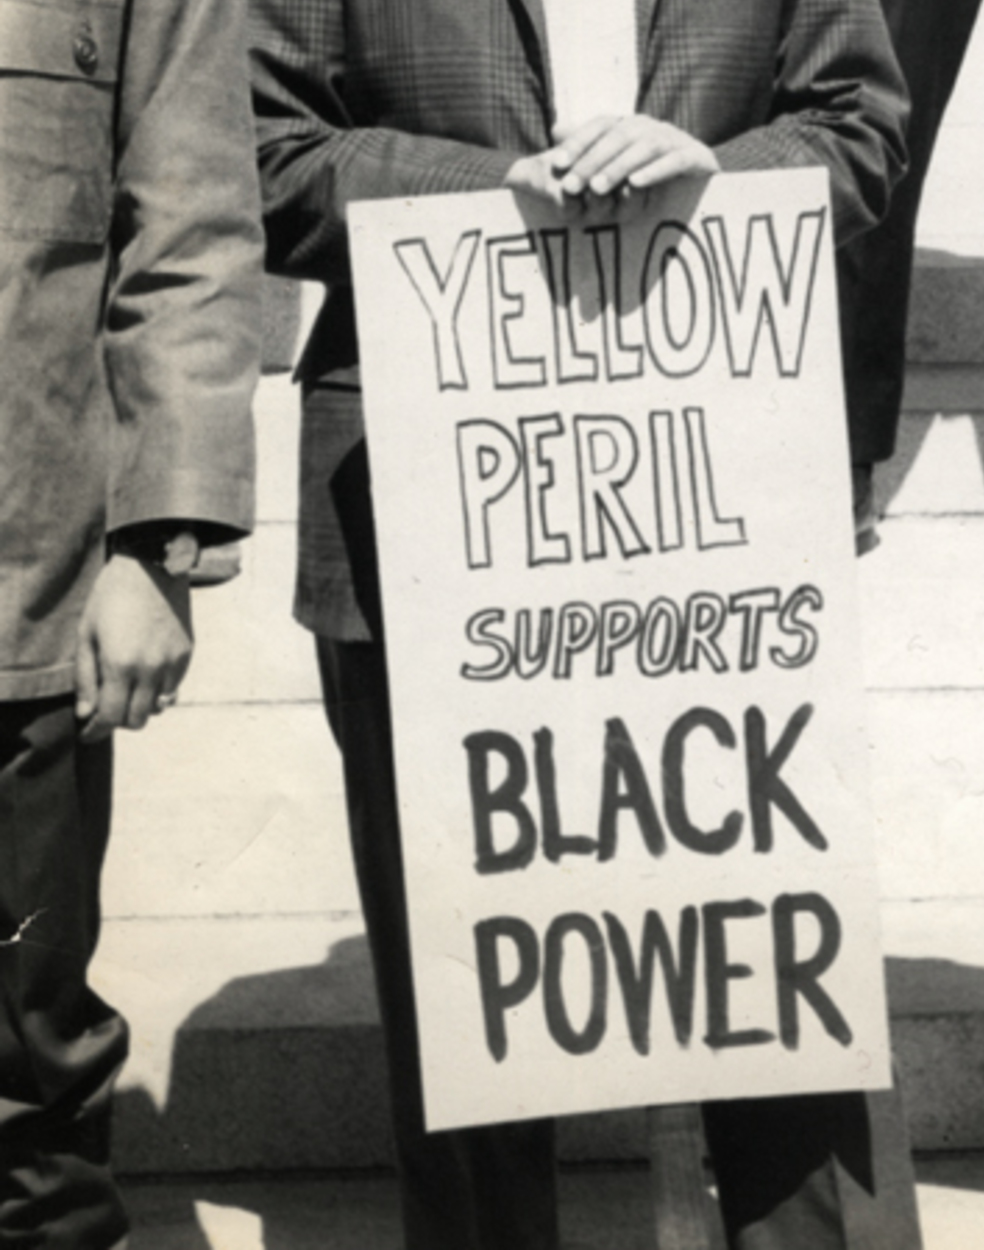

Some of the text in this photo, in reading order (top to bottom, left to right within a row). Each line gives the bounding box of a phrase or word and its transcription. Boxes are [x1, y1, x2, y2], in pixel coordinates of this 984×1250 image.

[393, 205, 826, 392] YELLOW
[456, 407, 748, 570] PERIL
[460, 584, 823, 681] SUPPORTS
[462, 702, 828, 875] BLACK
[473, 892, 853, 1064] POWER
